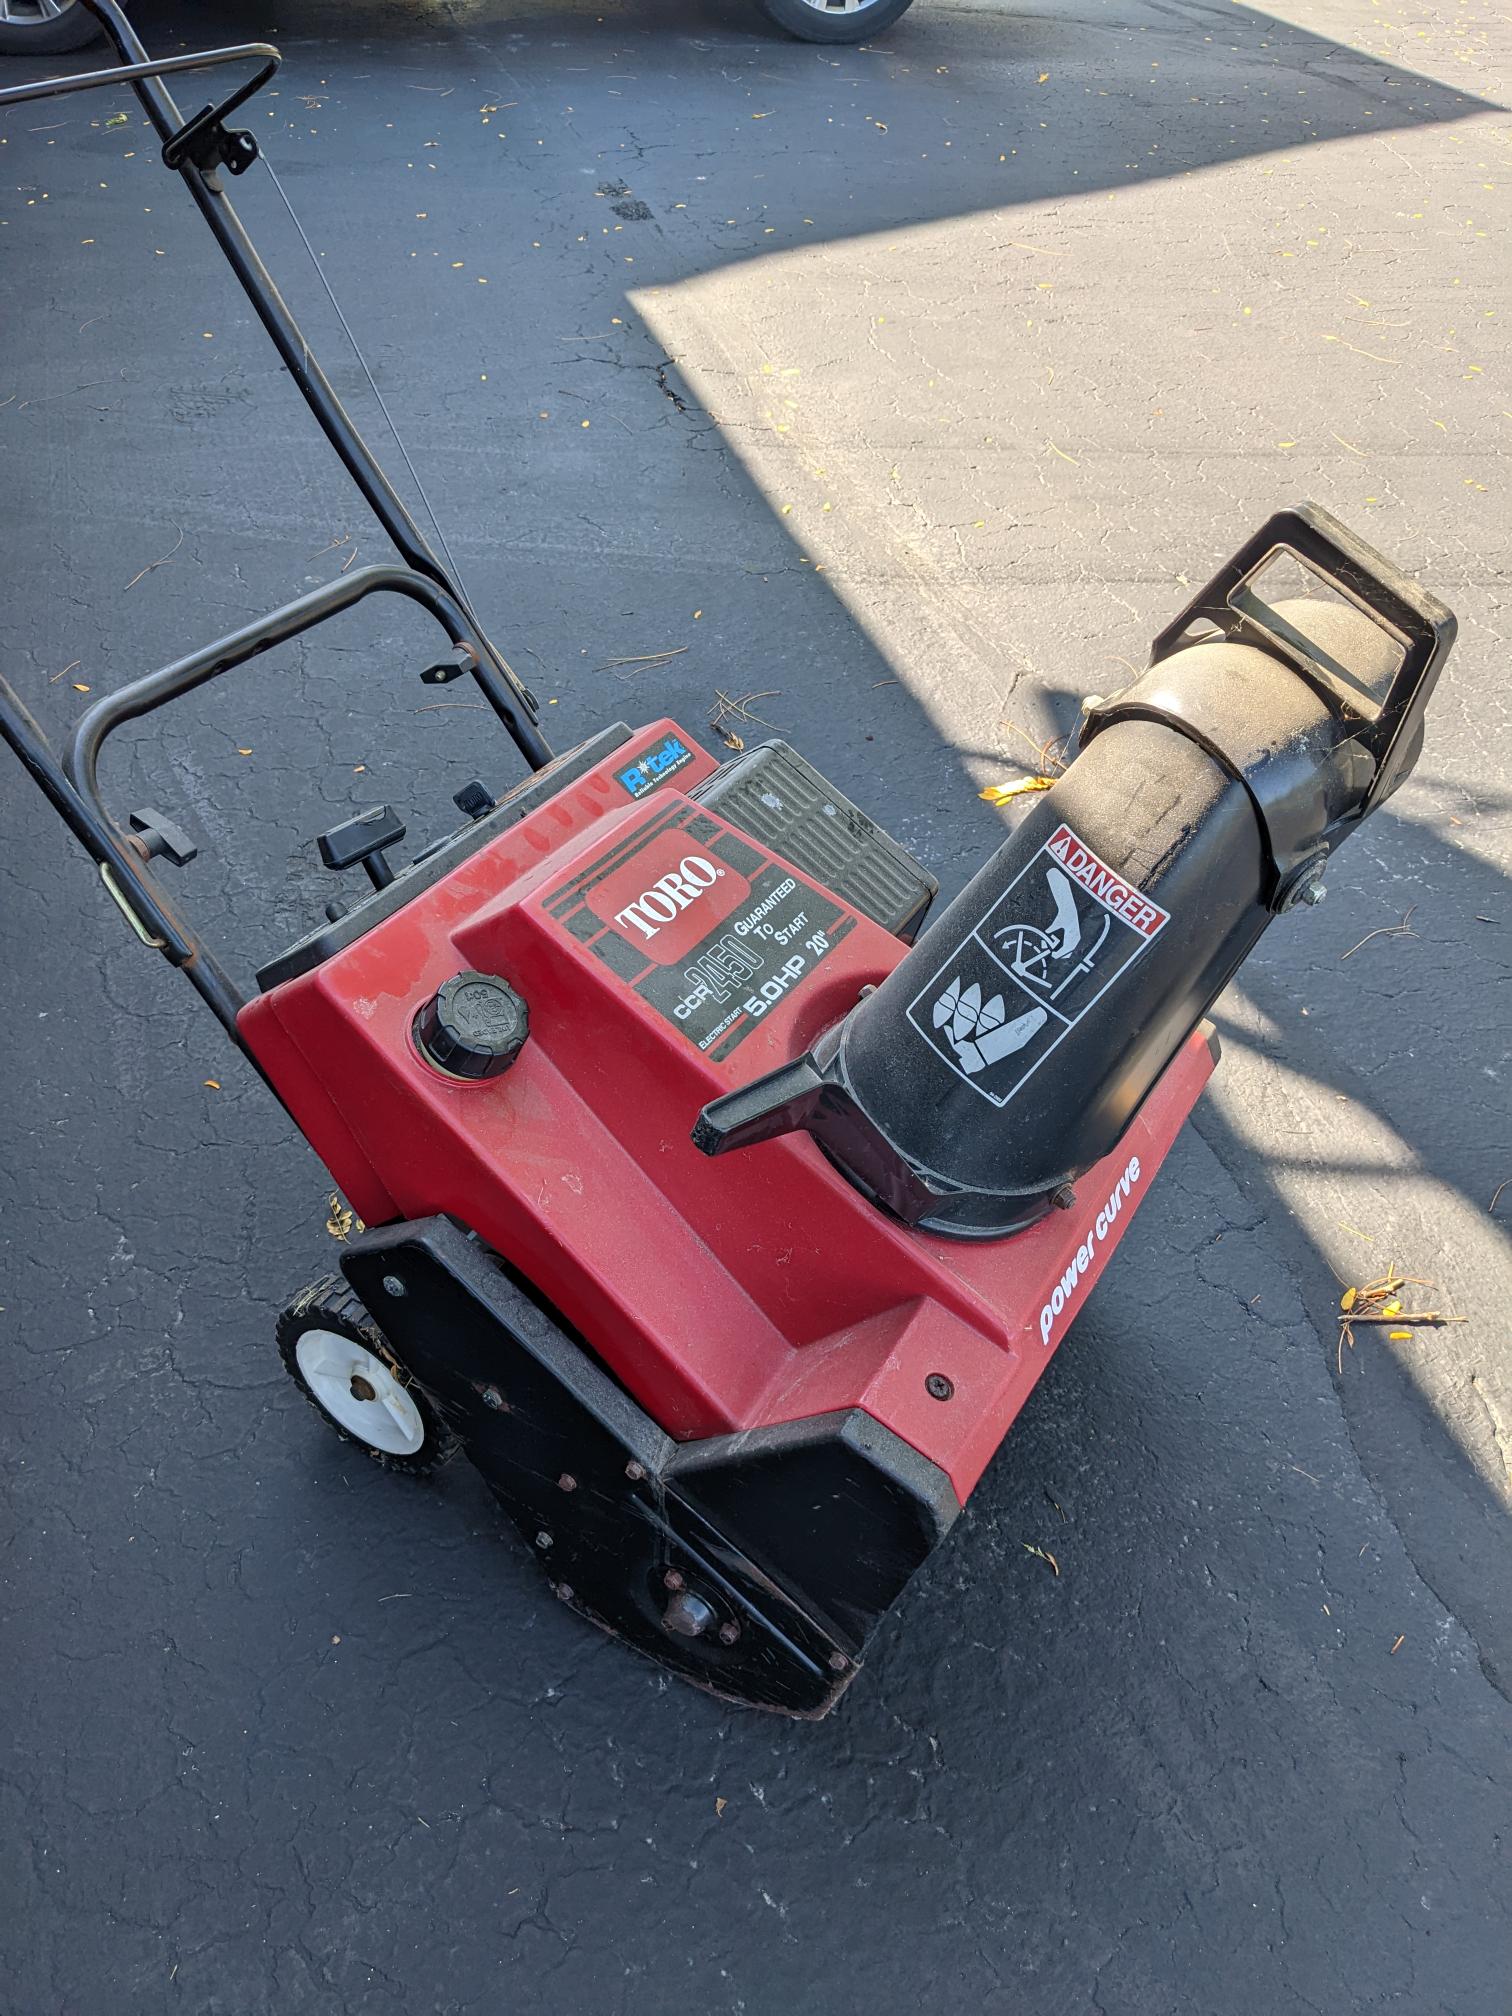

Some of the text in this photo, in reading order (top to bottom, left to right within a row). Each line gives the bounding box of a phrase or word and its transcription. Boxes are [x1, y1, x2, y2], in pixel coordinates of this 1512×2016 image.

[653, 763, 677, 783] Technology
[676, 752, 692, 766] Engine
[614, 856, 718, 940] TORO
[734, 878, 796, 936] GUARANTEED
[1066, 849, 1157, 931] DANGER
[774, 912, 809, 946] START
[698, 1006, 742, 1050] ELECTRIC START
[1040, 1156, 1140, 1346] power curve
